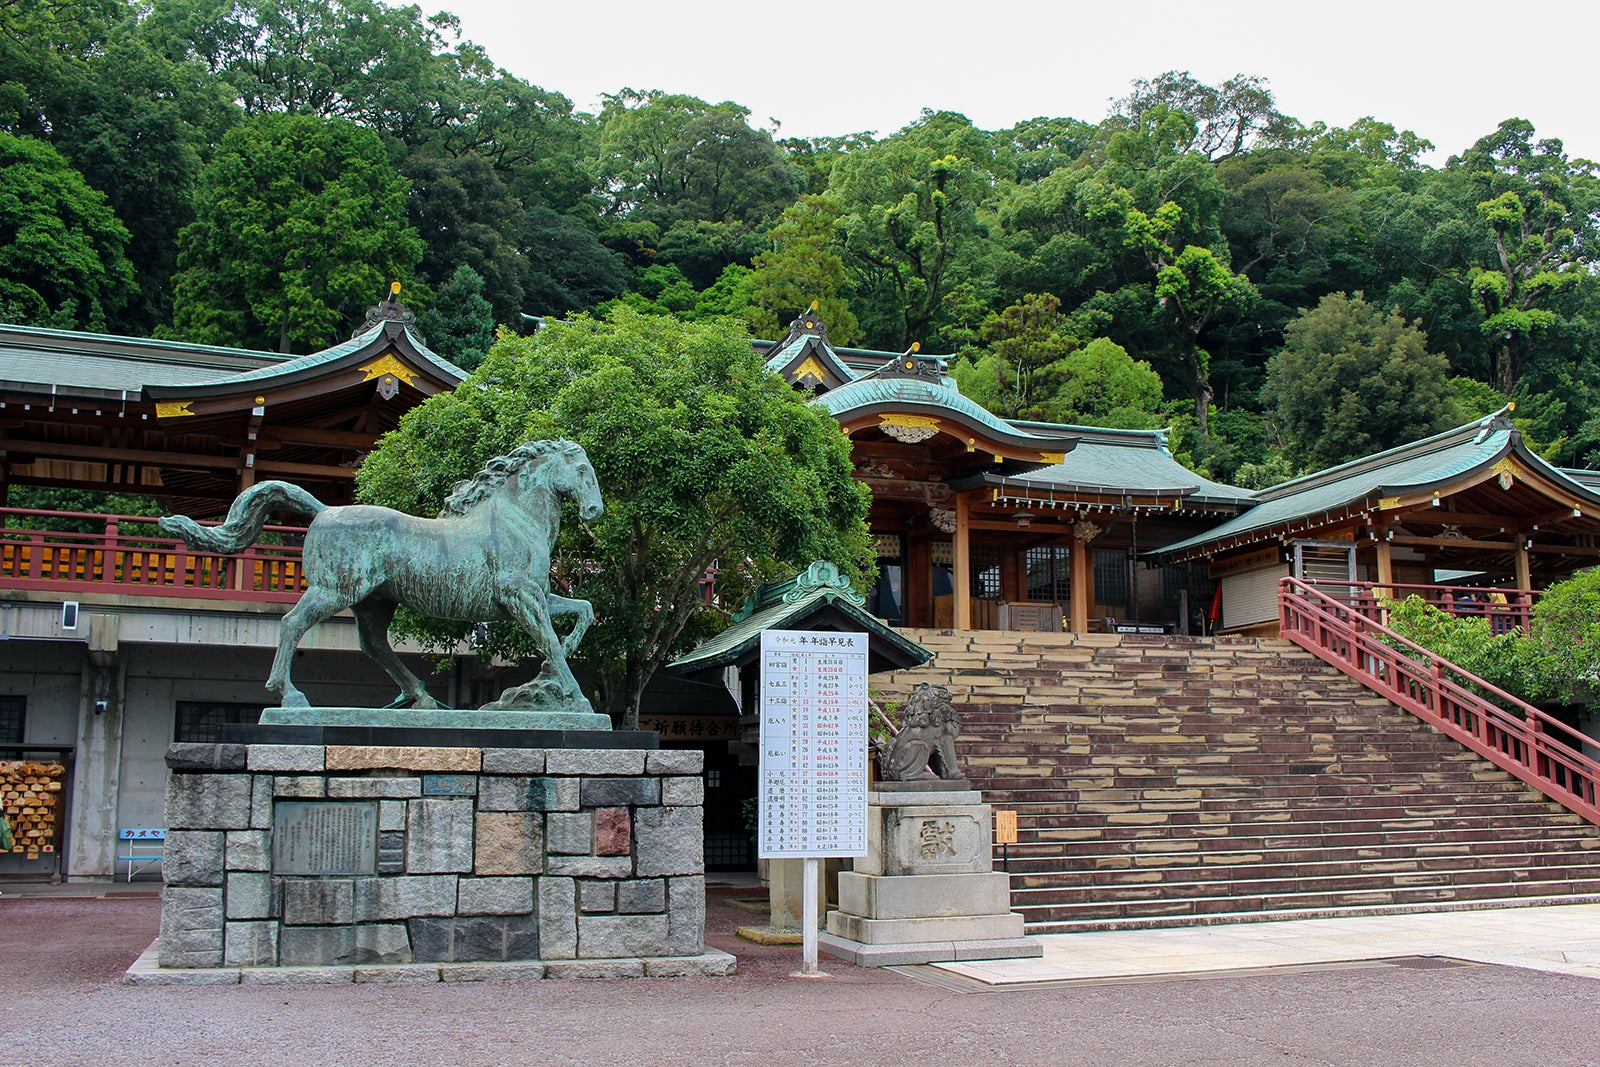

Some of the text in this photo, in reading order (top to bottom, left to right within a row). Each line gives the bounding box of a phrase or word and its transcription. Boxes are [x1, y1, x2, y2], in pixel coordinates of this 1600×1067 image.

[640, 719, 742, 736] ご祈願待合所
[125, 830, 166, 838] カメヤ
